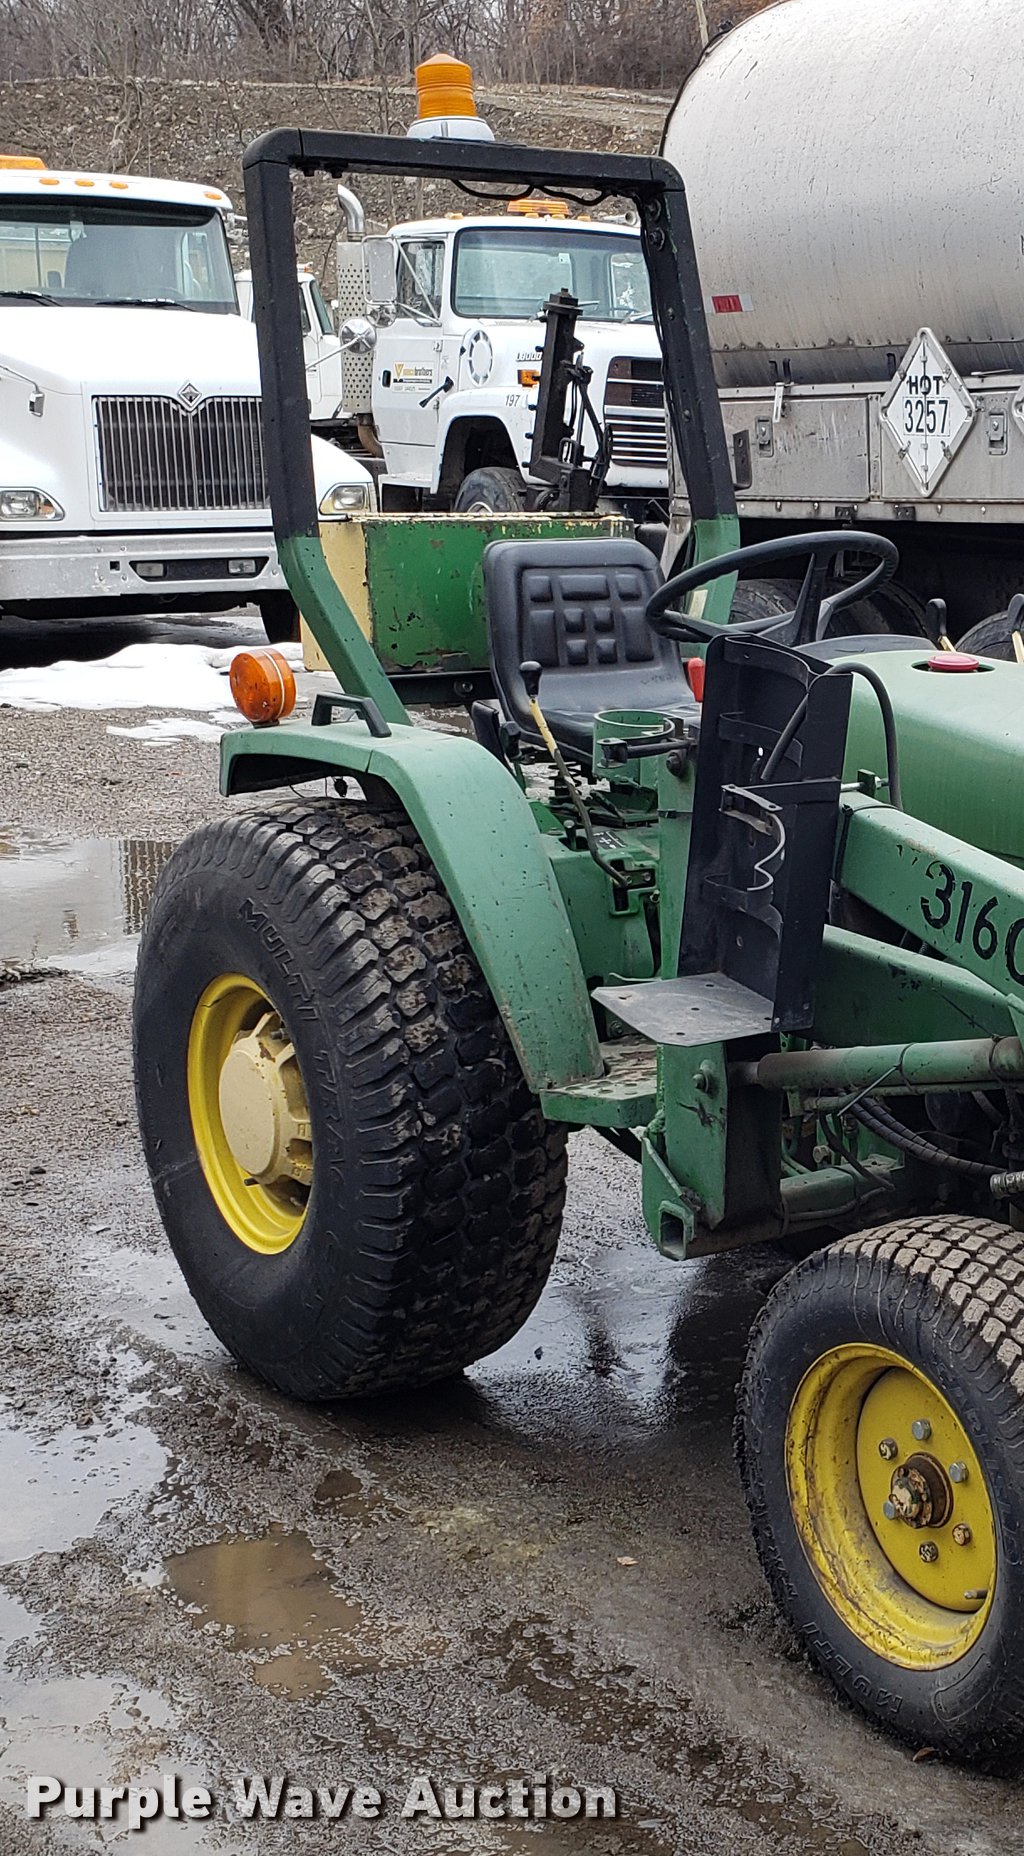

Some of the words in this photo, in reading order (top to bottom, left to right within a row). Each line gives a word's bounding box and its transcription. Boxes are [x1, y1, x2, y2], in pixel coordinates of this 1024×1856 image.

[904, 399, 949, 434] 3257
[908, 375, 943, 395] HOT
[238, 897, 319, 1020] MULTI
[802, 1621, 903, 1713] MULTI
